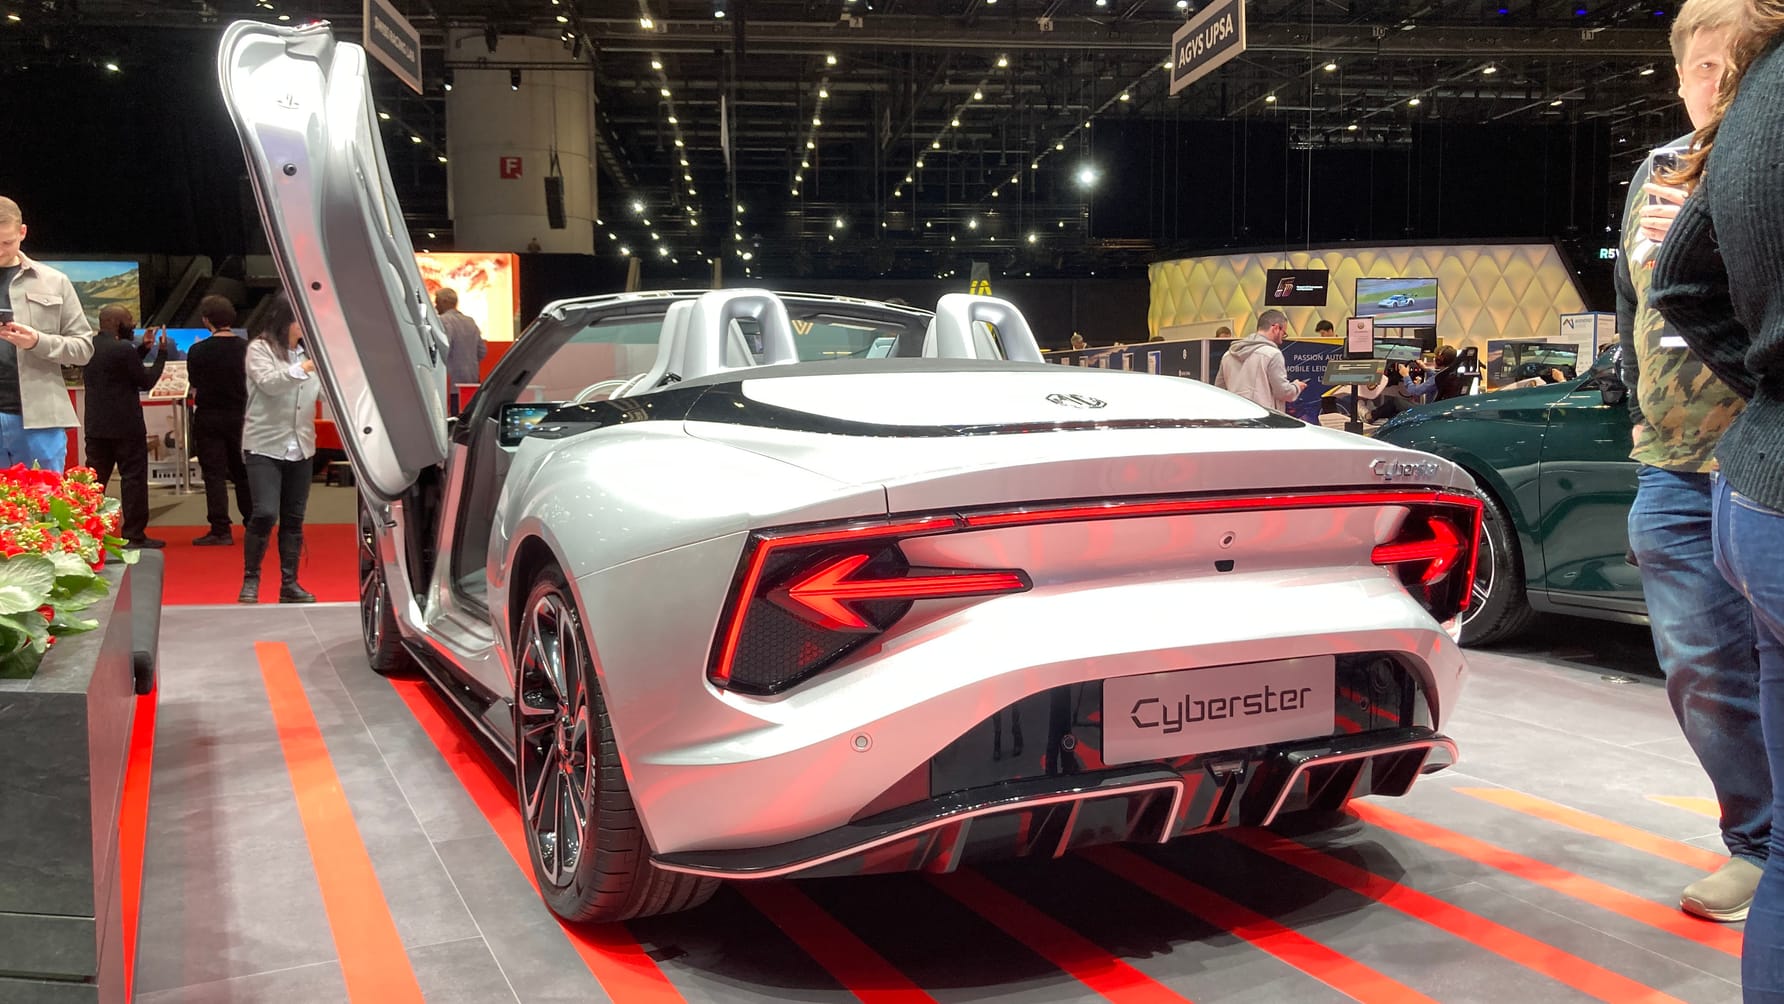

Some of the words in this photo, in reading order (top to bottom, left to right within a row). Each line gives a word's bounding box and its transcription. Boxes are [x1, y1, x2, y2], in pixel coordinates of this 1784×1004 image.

[1178, 33, 1204, 69] AGVS
[1205, 13, 1234, 49] UPSA
[506, 159, 518, 174] F
[1369, 458, 1441, 480] Cyberster
[1130, 685, 1312, 734] Cyberster
